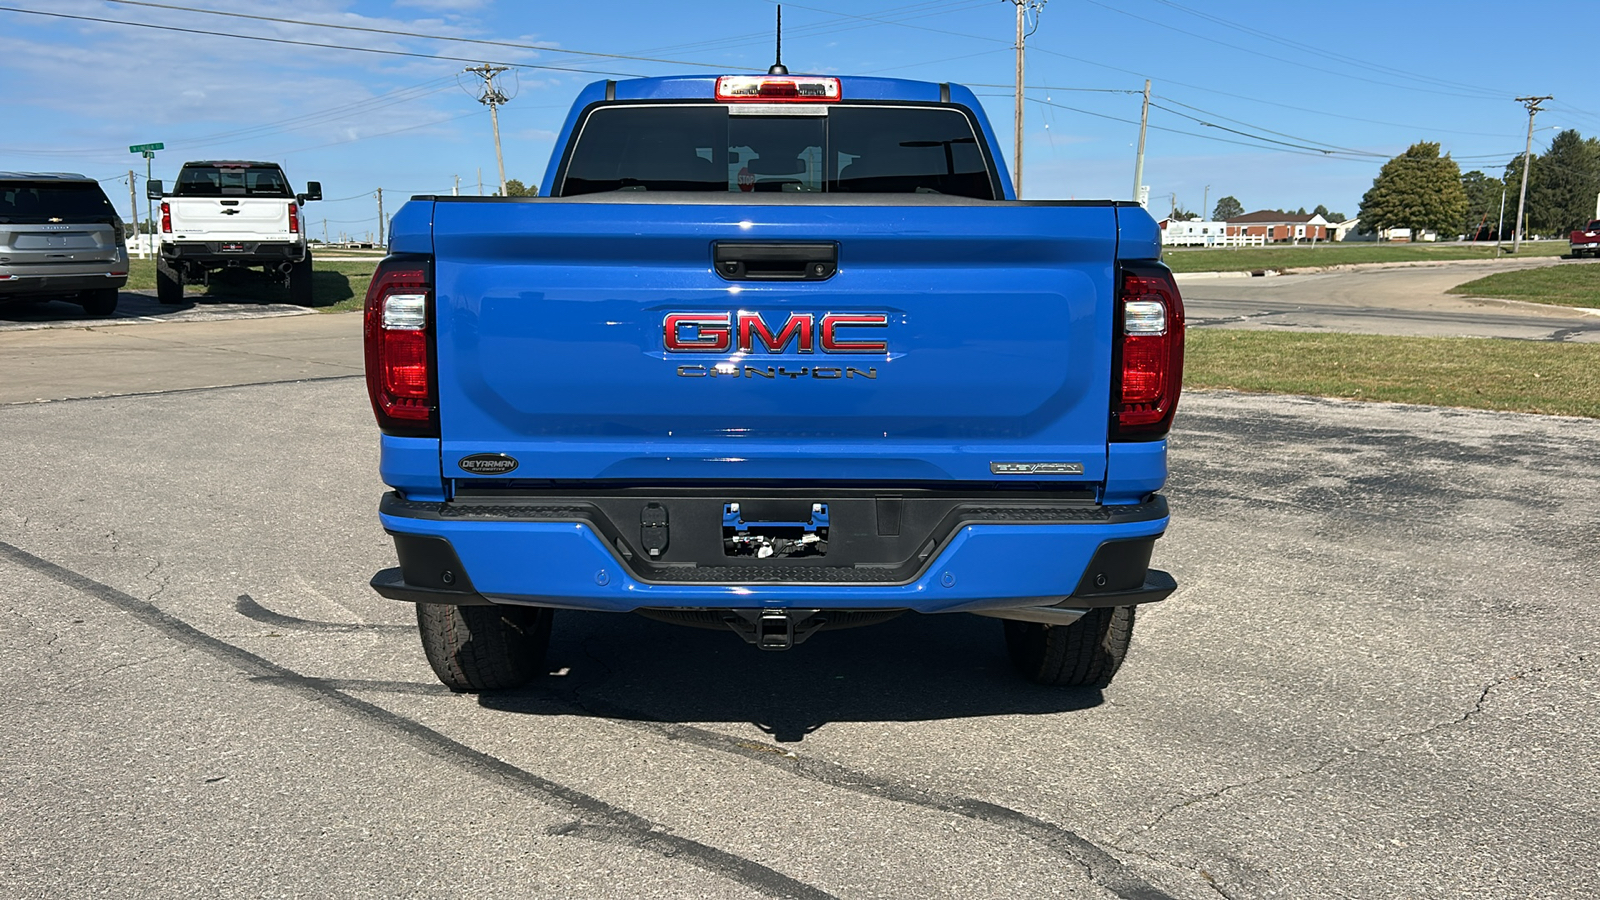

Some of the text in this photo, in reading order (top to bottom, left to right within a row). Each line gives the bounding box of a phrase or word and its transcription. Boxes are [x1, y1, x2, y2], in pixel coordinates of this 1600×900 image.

[738, 175, 755, 185] STOP
[663, 311, 888, 354] GMC
[677, 364, 877, 379] CANYON
